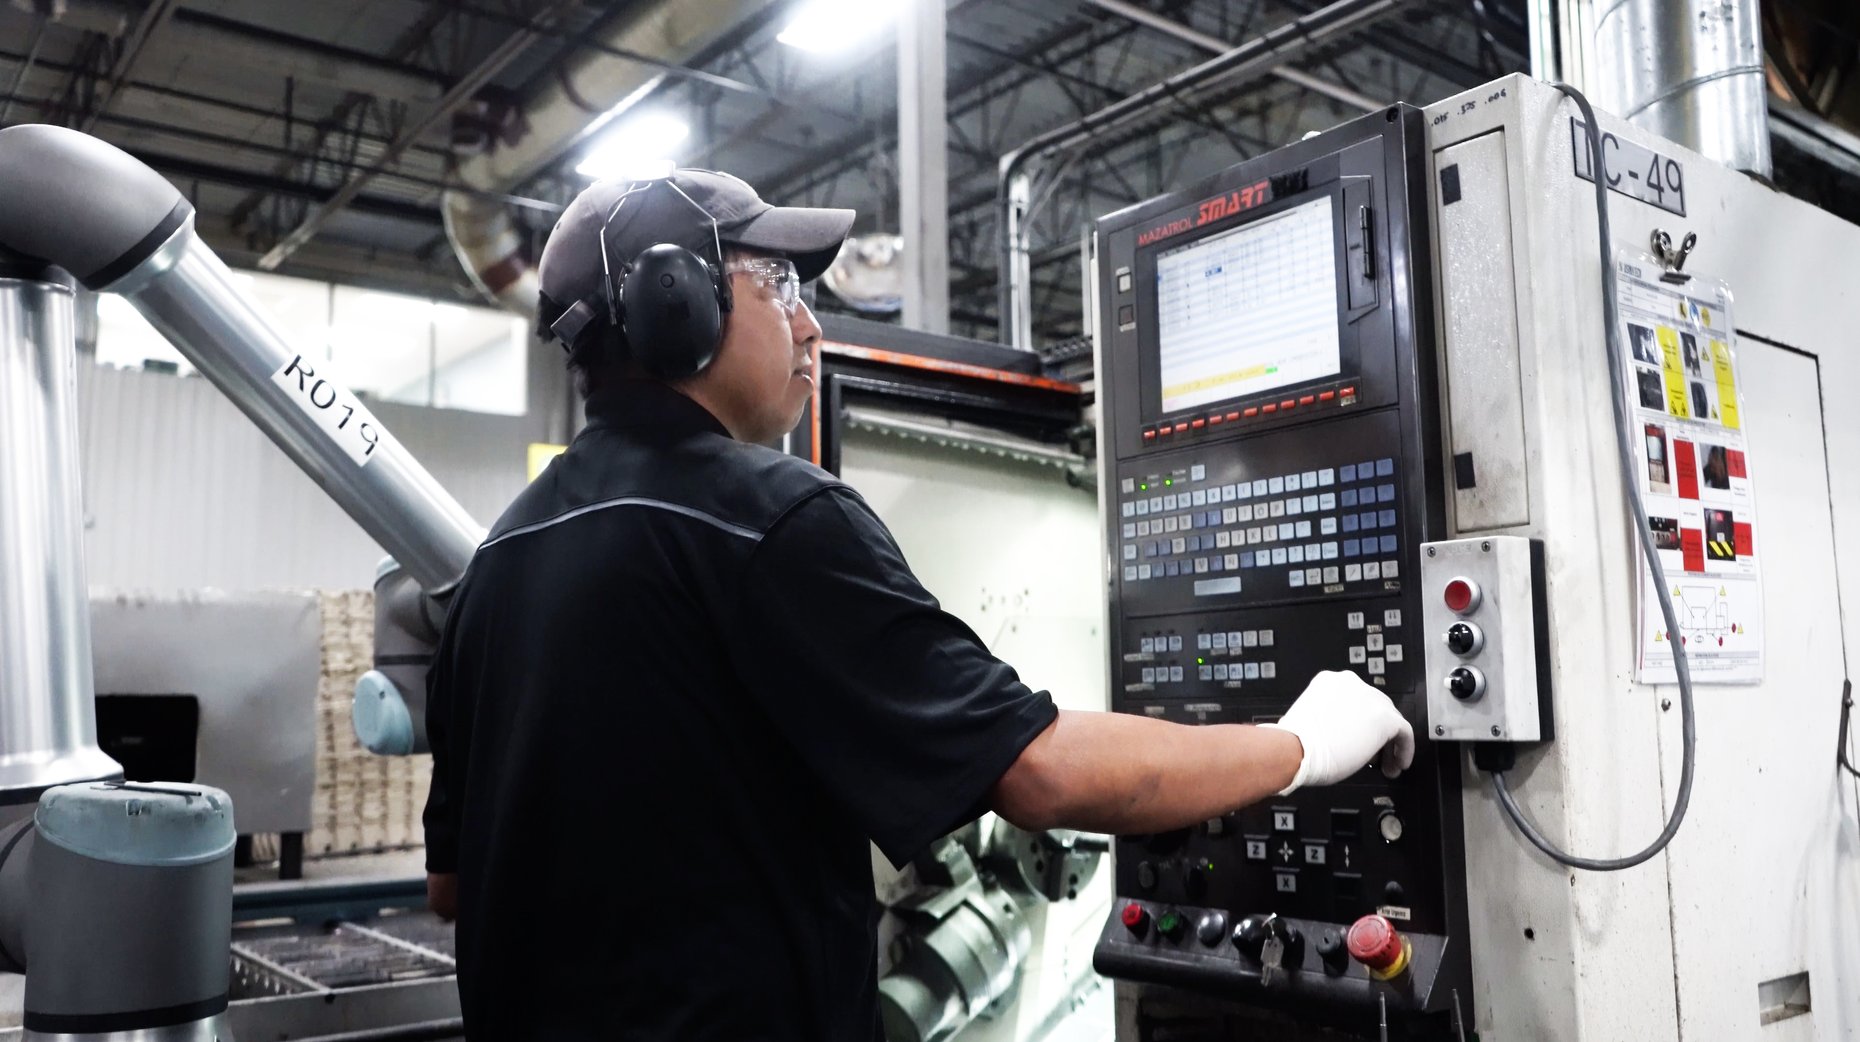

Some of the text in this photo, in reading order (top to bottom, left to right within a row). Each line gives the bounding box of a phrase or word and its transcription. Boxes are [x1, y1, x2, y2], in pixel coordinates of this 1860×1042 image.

[1575, 119, 1684, 212] TC-49
[1137, 180, 1269, 247] MAZATROL SMART
[1281, 816, 1288, 827] X
[1252, 844, 1319, 860] Z Z
[1283, 877, 1290, 889] X
